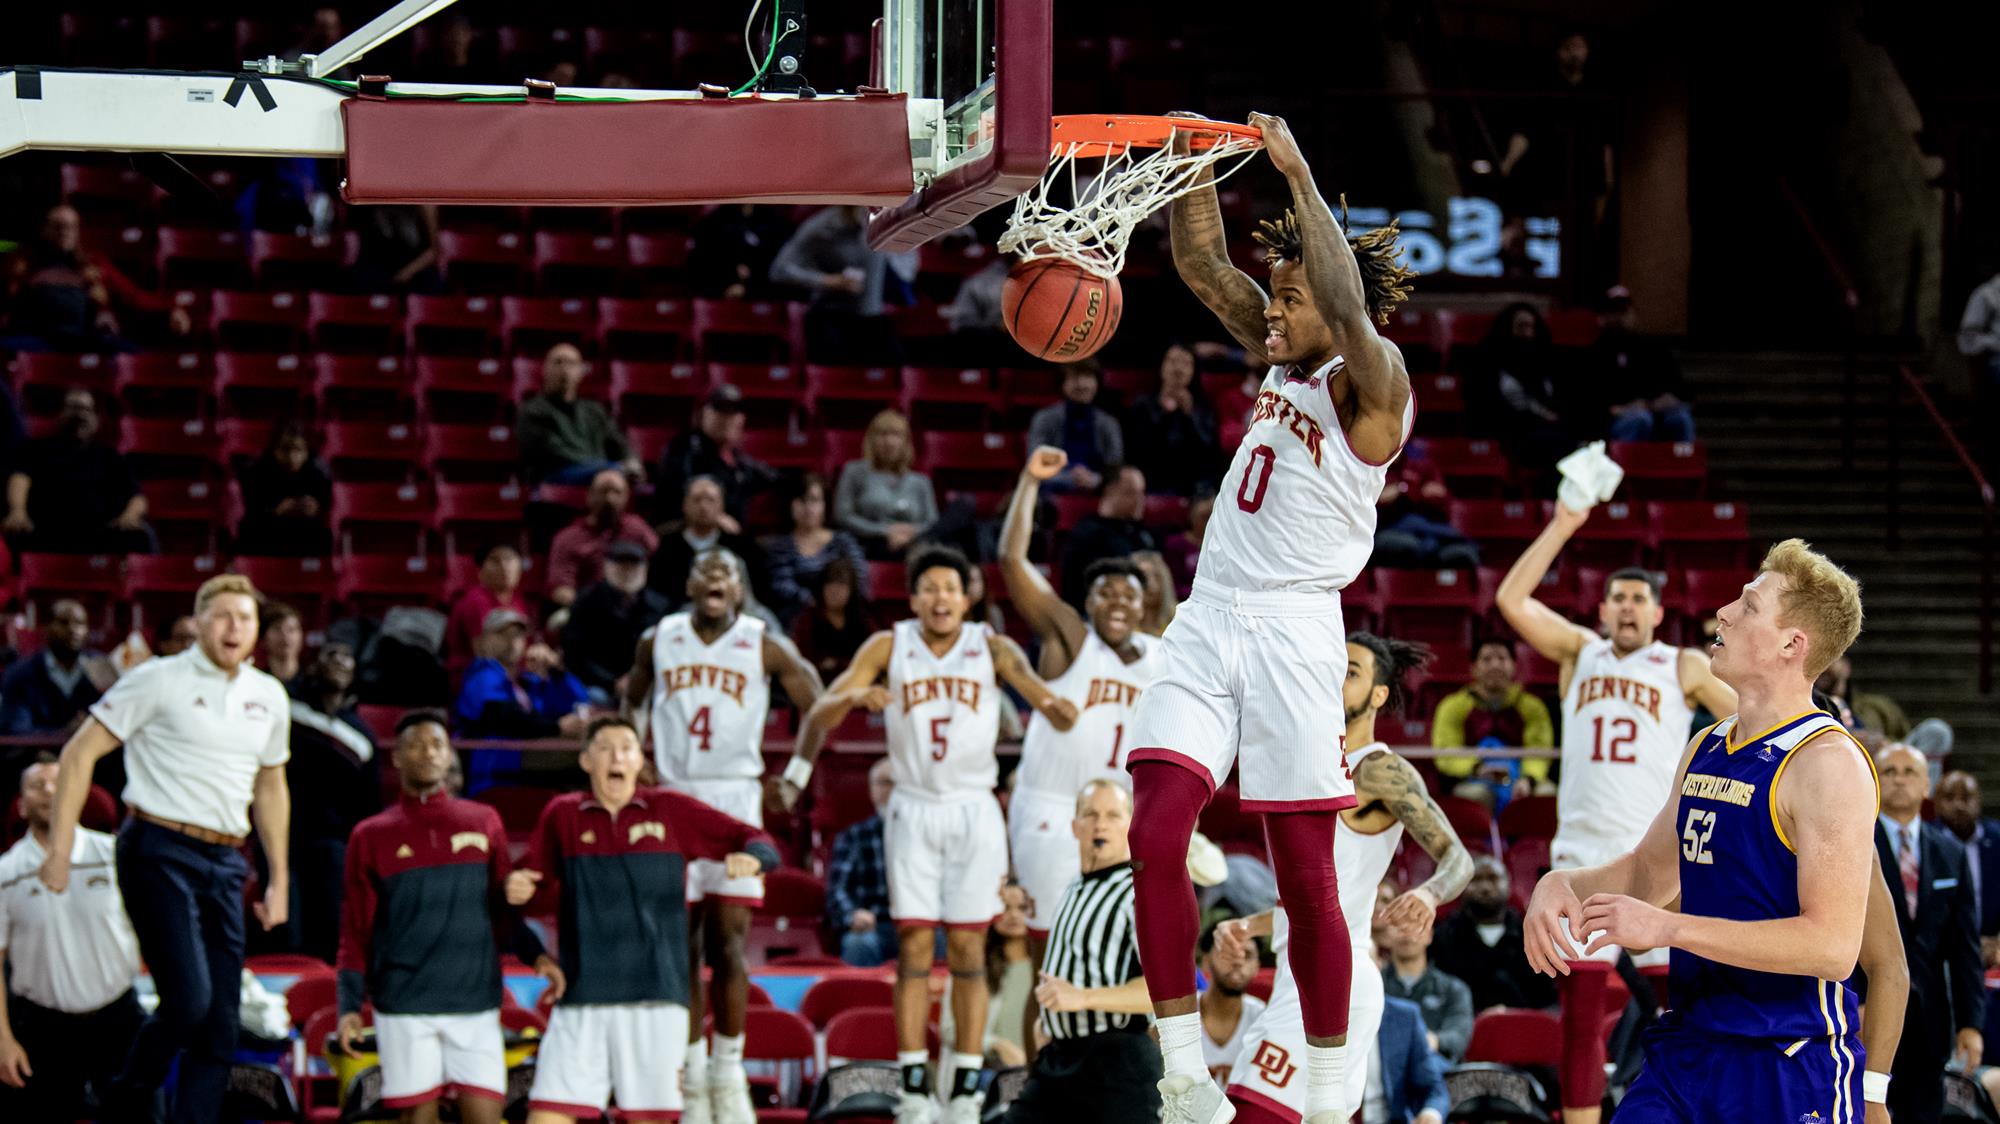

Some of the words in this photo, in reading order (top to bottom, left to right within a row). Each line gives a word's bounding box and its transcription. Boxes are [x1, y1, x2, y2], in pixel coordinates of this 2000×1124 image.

[1053, 287, 1103, 356] Wilson
[1236, 443, 1277, 515] 0
[662, 663, 748, 709] DENVER
[901, 676, 981, 717] DENVER
[1574, 674, 1663, 726] DENVER
[688, 704, 713, 752] 4
[930, 716, 952, 763] 5
[1589, 713, 1639, 765] 12
[1682, 807, 1717, 865] 52
[1249, 1039, 1297, 1089] DU
